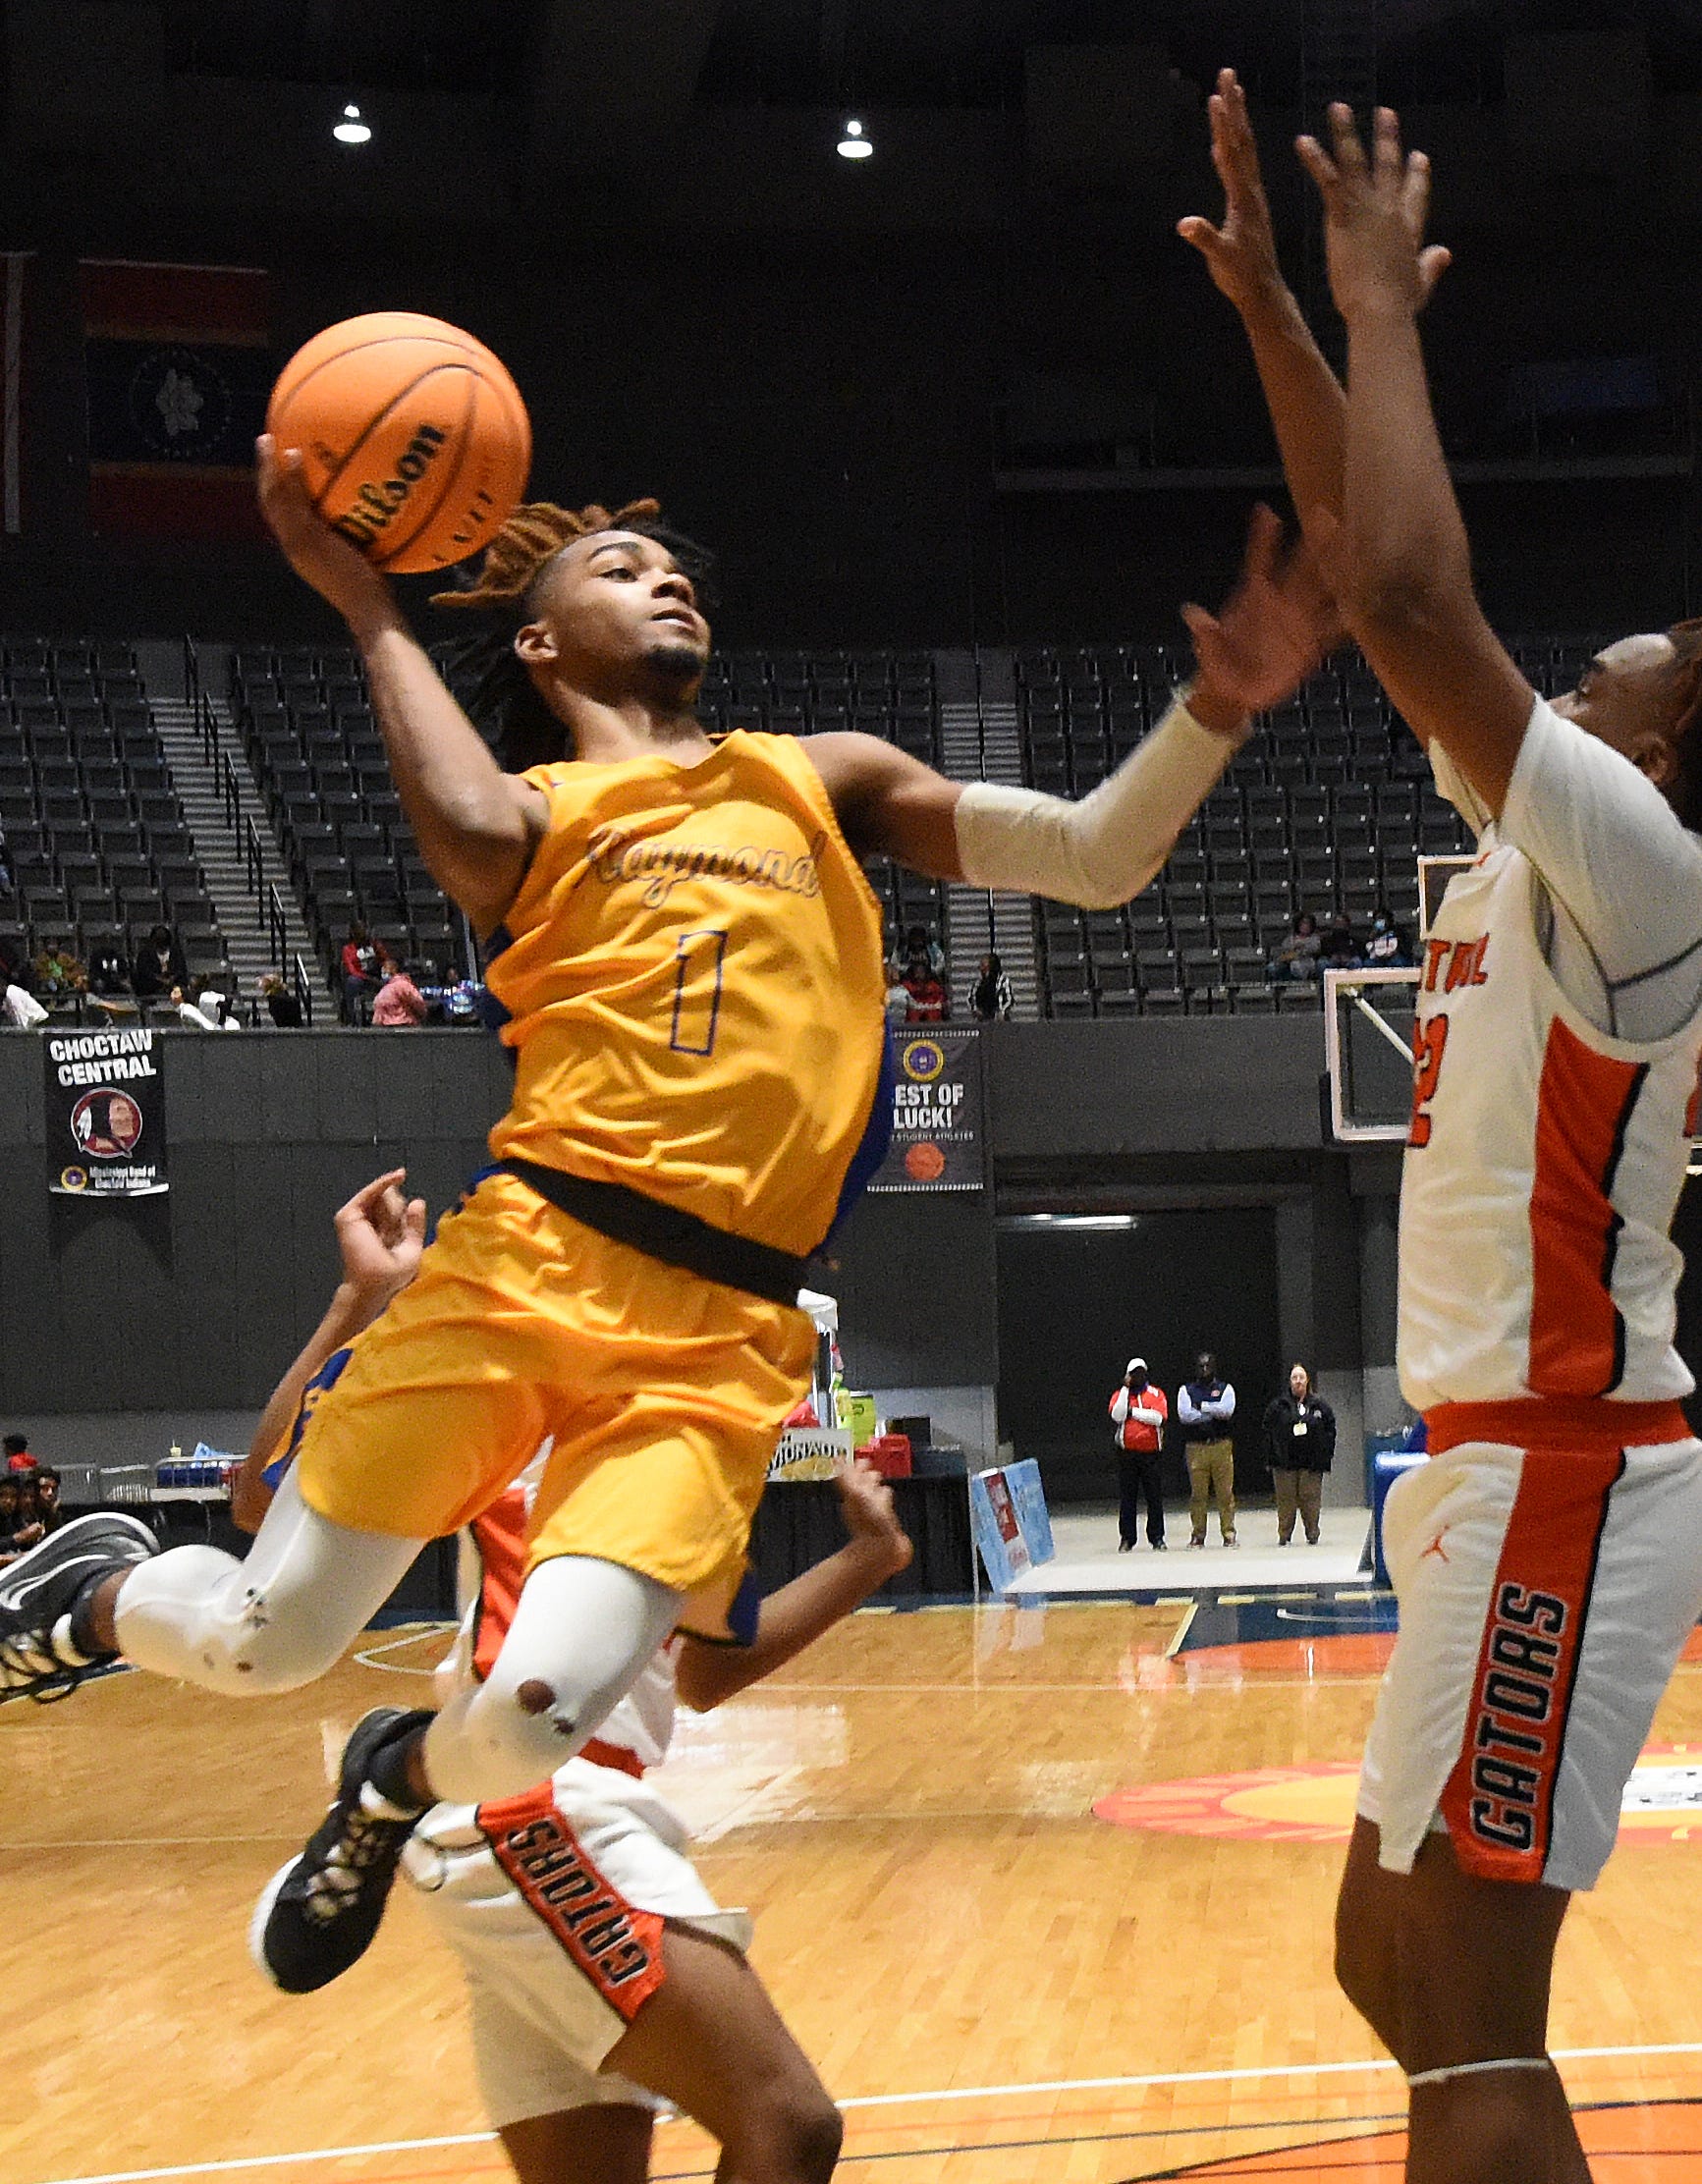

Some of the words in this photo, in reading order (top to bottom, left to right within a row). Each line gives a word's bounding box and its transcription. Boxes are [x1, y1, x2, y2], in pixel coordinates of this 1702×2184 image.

[670, 930, 728, 1057] 1
[49, 1029, 152, 1063] CHOCTAW
[58, 1055, 157, 1087] CENTRAL
[895, 1083, 933, 1107] EST
[938, 1083, 964, 1106] OF
[893, 1107, 953, 1129] LUCK!
[1469, 1582, 1568, 1854] GATORS
[505, 1817, 649, 1990] GATORS
